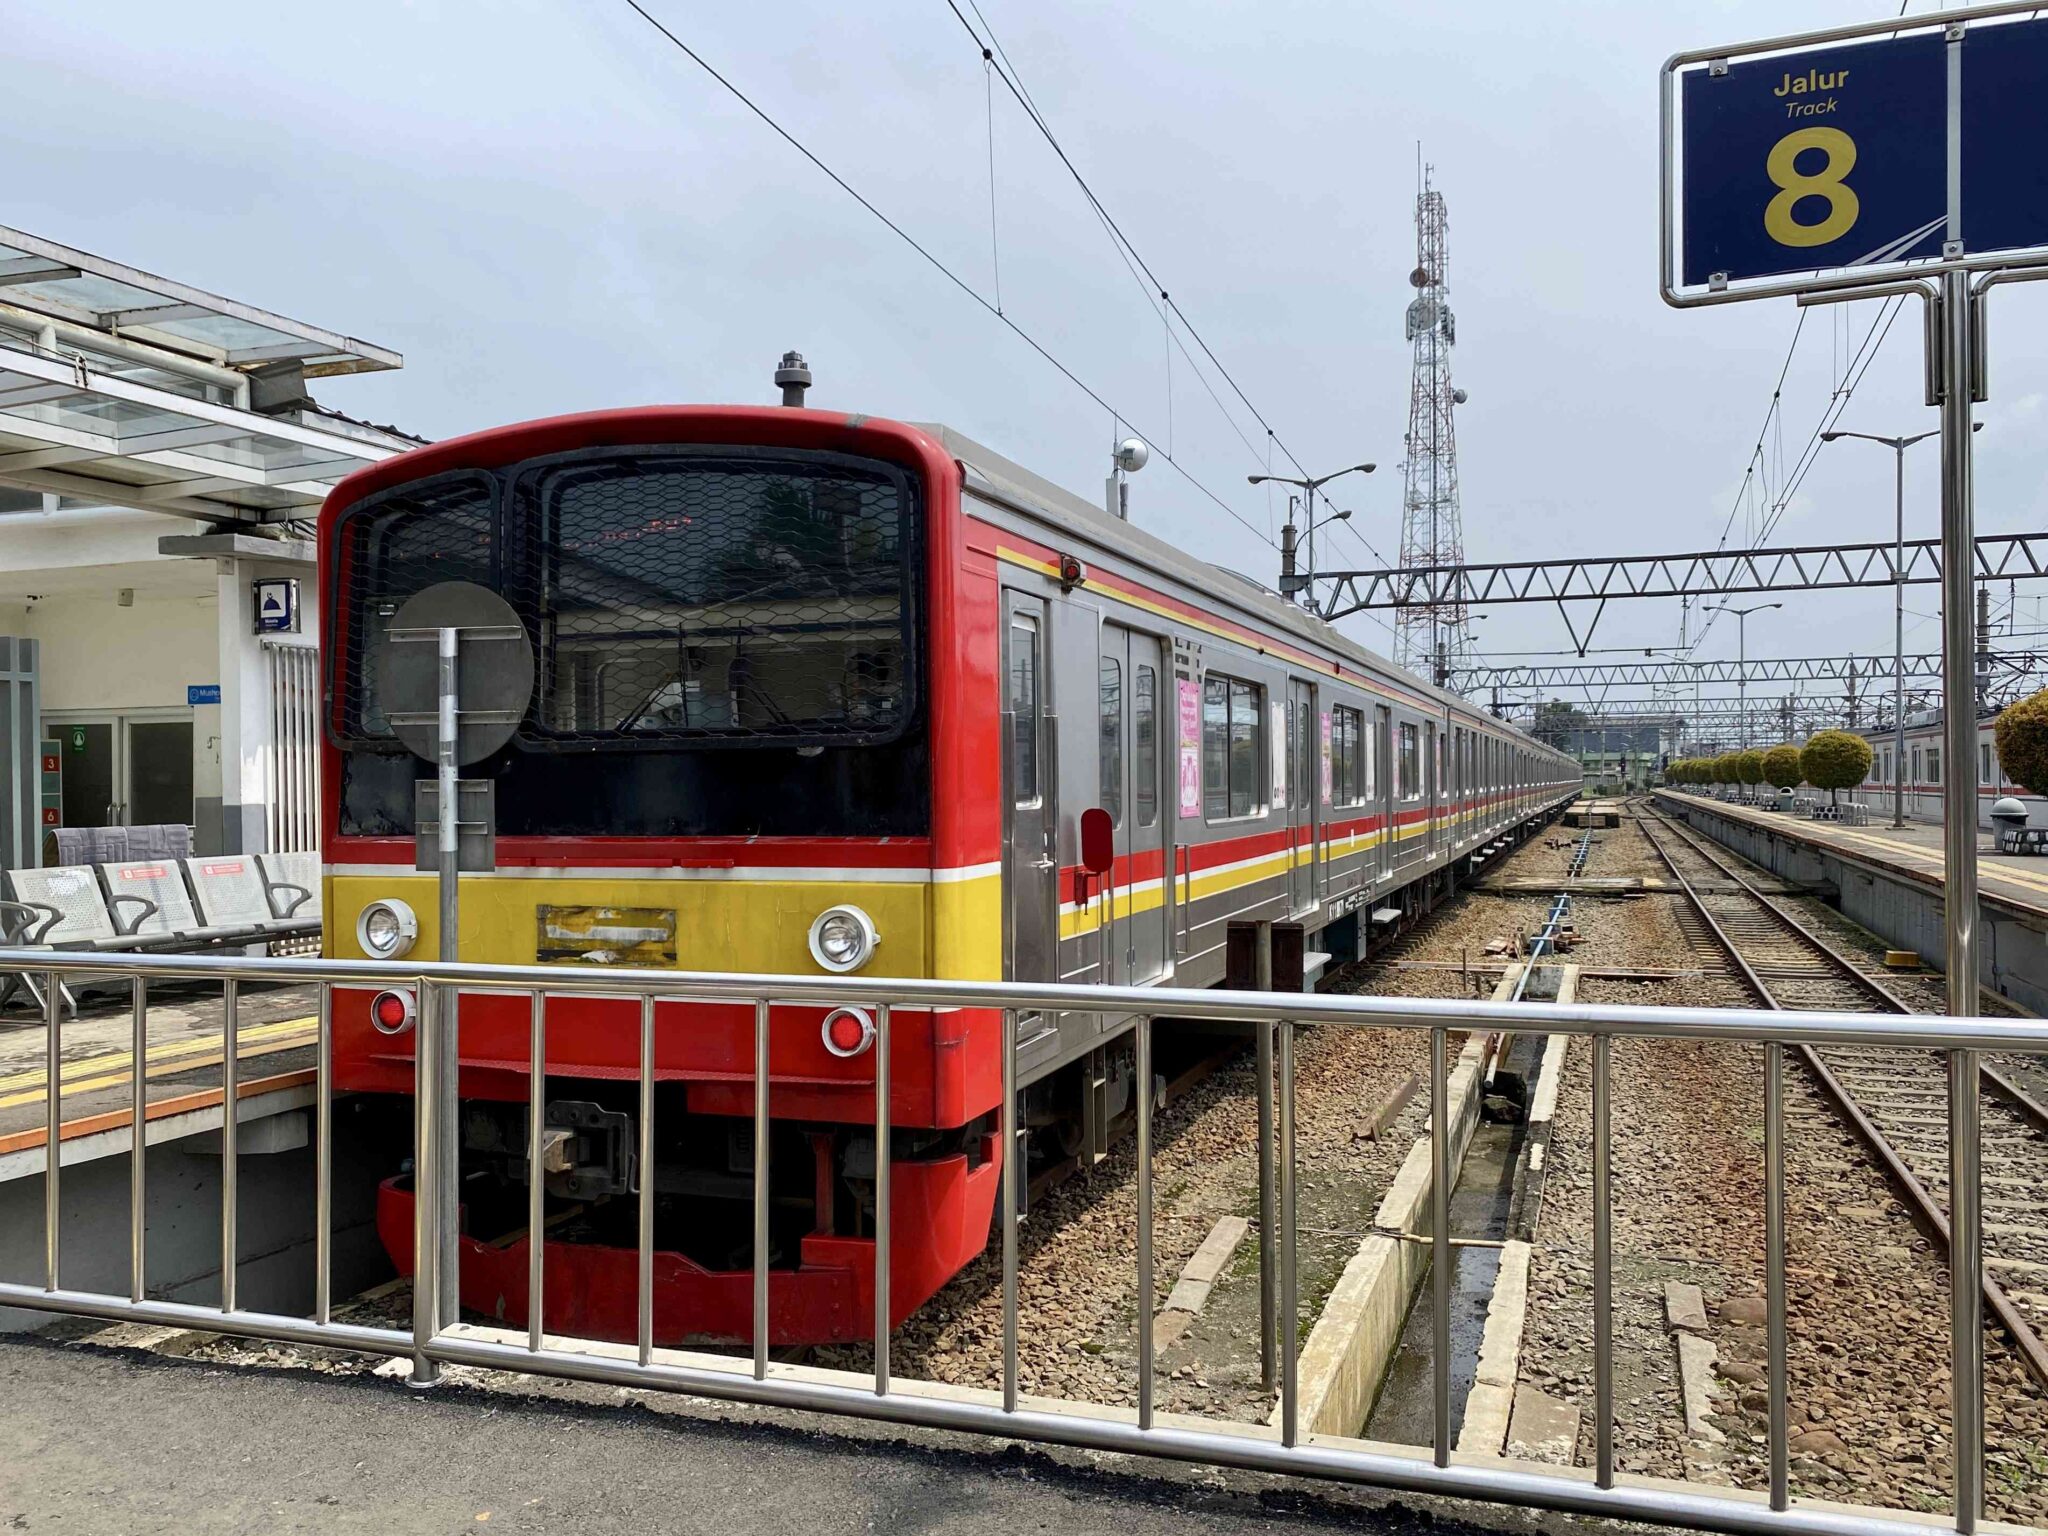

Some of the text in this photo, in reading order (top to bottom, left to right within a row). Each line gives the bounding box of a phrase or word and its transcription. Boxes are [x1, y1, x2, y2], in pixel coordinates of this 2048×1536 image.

[1774, 69, 1850, 97] Jalur
[1785, 97, 1839, 119] Track
[1764, 126, 1860, 248] 8
[48, 758, 55, 769] 3
[47, 811, 55, 822] 6
